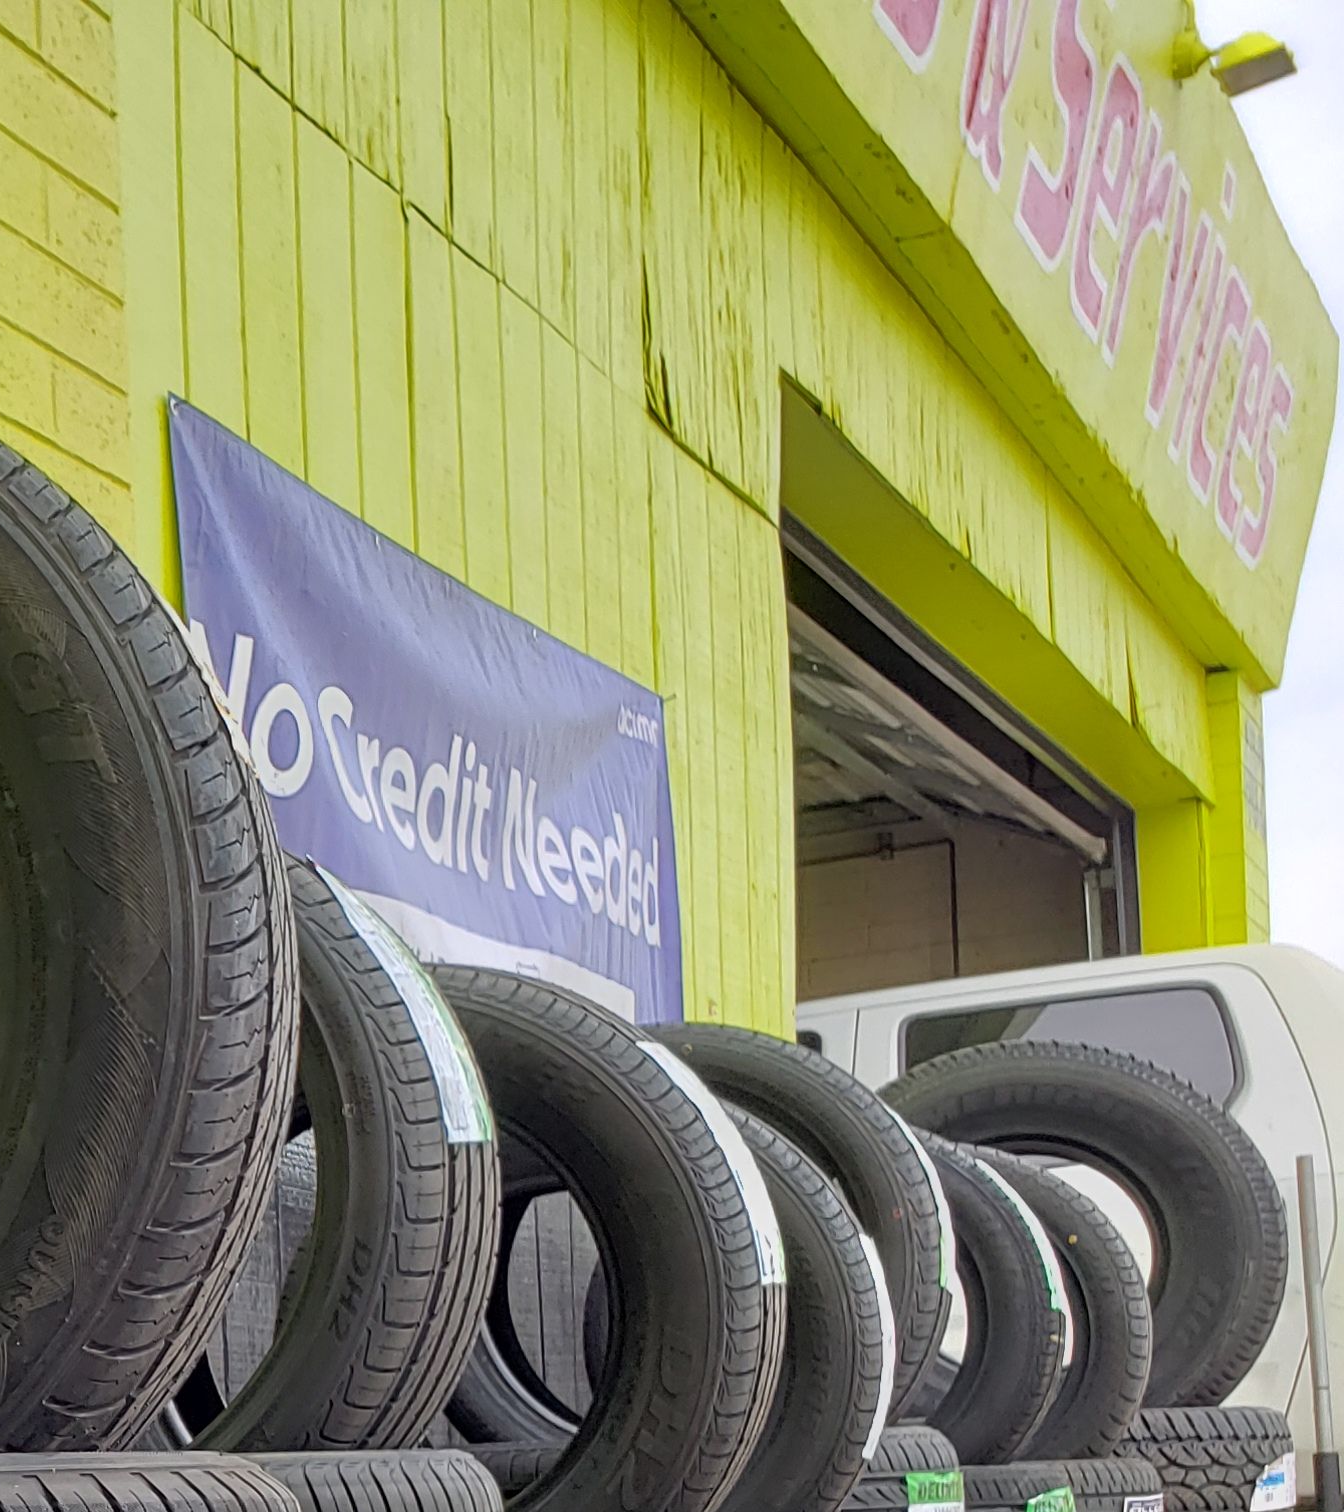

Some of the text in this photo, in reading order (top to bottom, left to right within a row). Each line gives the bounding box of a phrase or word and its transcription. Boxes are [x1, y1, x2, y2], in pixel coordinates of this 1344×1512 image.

[1015, 0, 1294, 570] Services
[318, 685, 491, 882] Credit
[502, 767, 662, 949] Needed
